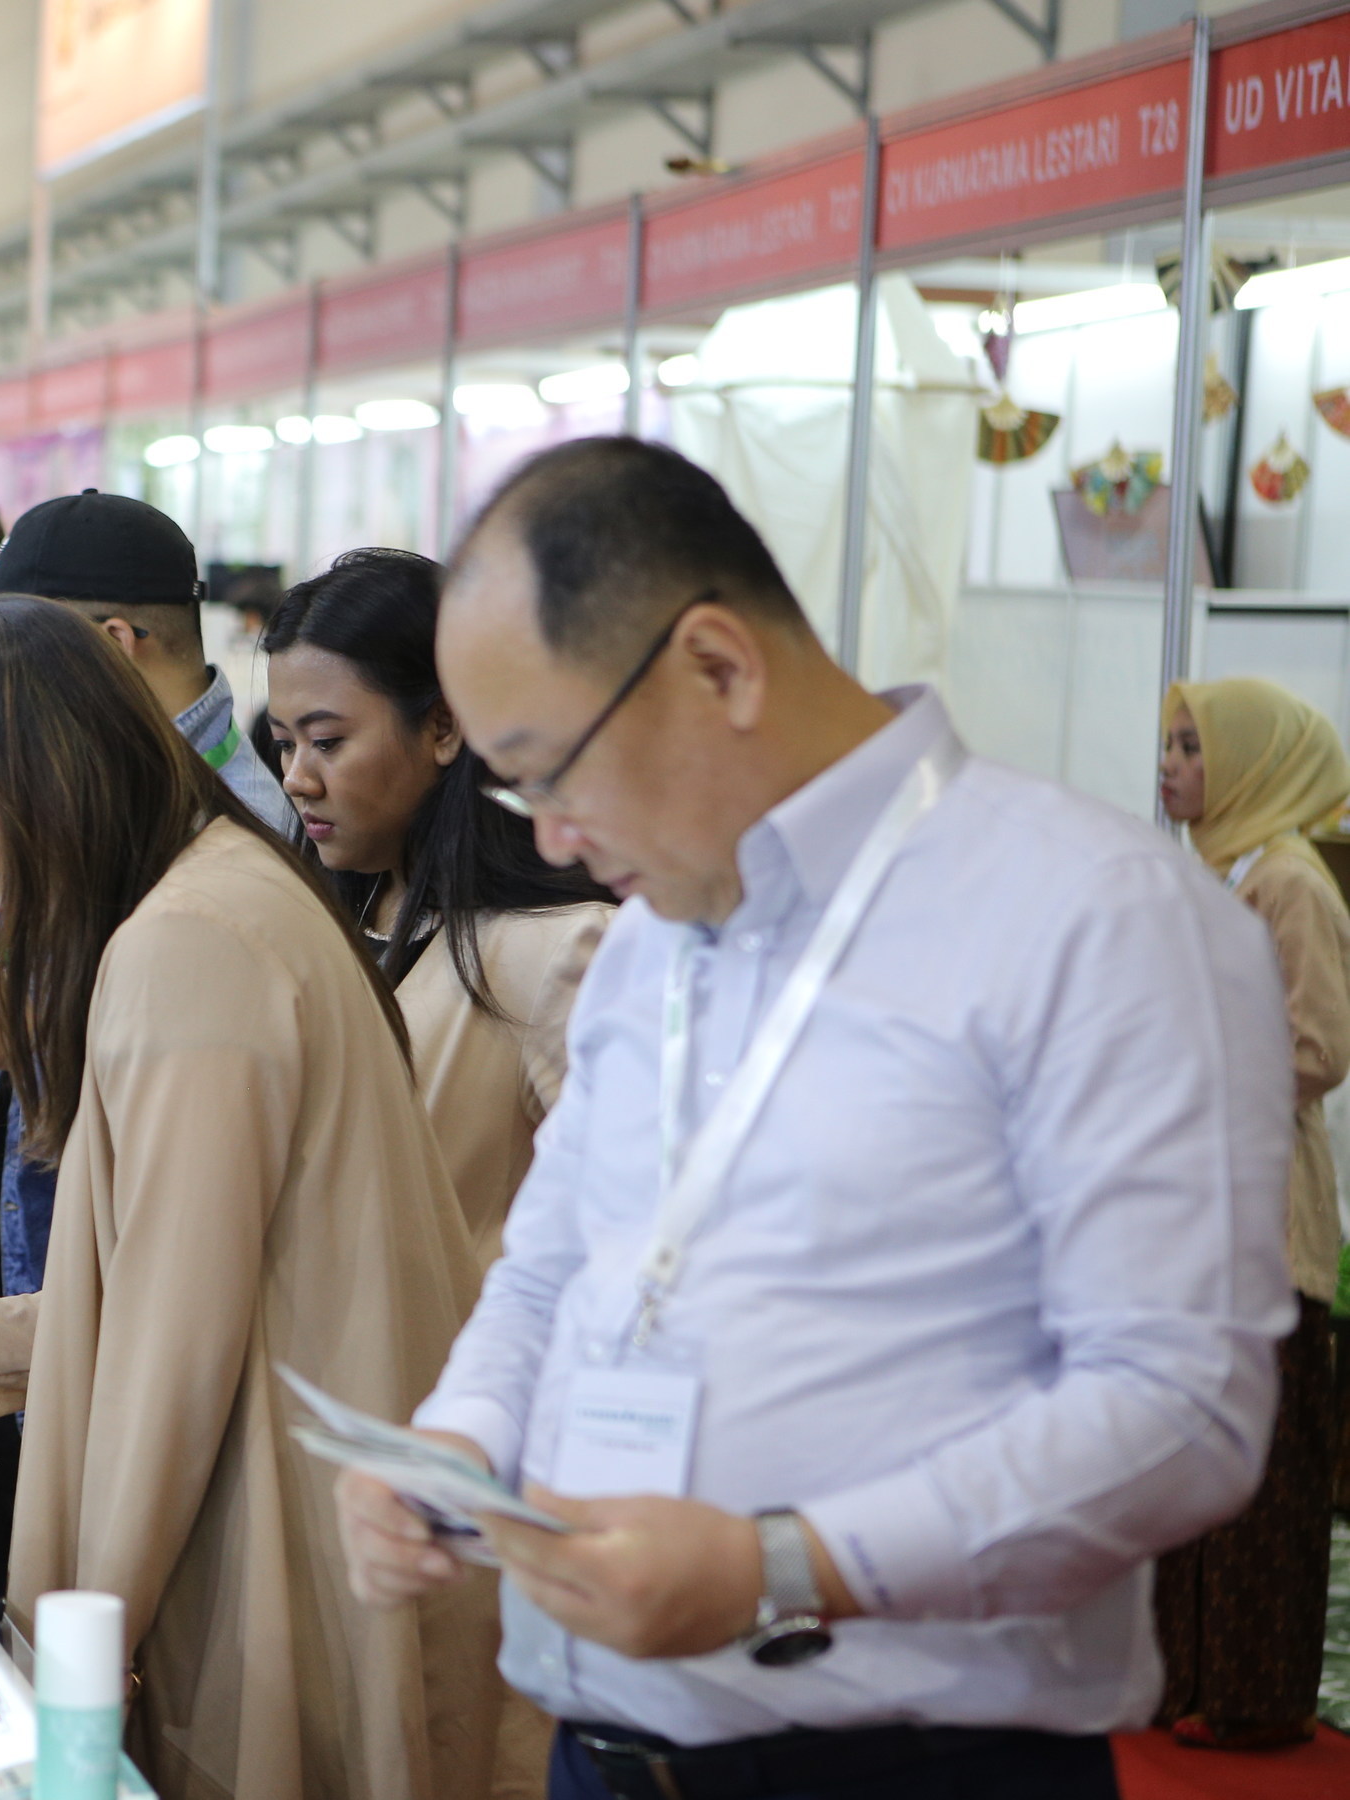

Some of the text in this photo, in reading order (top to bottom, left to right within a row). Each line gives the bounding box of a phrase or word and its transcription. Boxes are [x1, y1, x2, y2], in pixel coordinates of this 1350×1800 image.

[1224, 53, 1350, 135] UD VITA
[1034, 111, 1122, 185] LESTARI
[1138, 98, 1180, 159] T28
